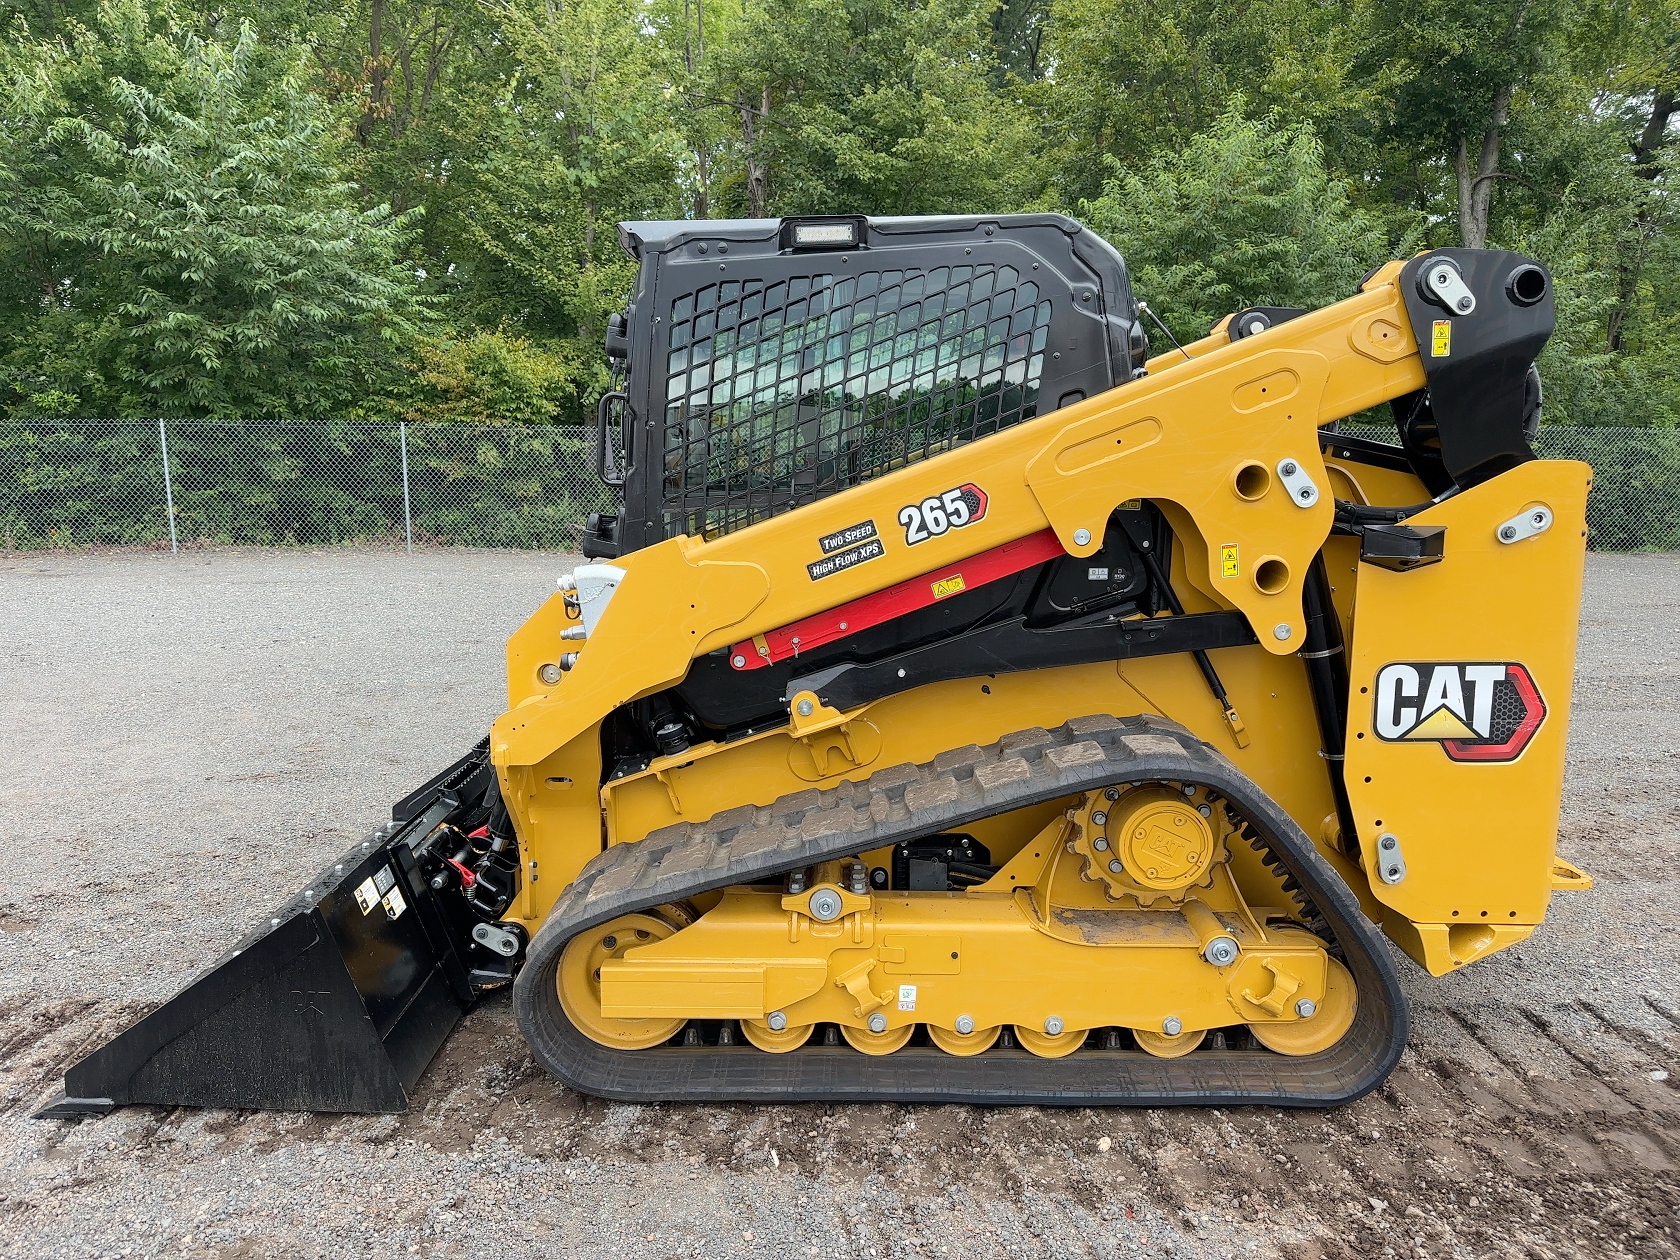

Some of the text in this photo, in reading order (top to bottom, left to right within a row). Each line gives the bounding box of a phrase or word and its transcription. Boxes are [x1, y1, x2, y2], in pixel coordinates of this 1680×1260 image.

[900, 488, 970, 544] 265
[860, 543, 879, 558] XPS
[1376, 664, 1506, 739] CAT
